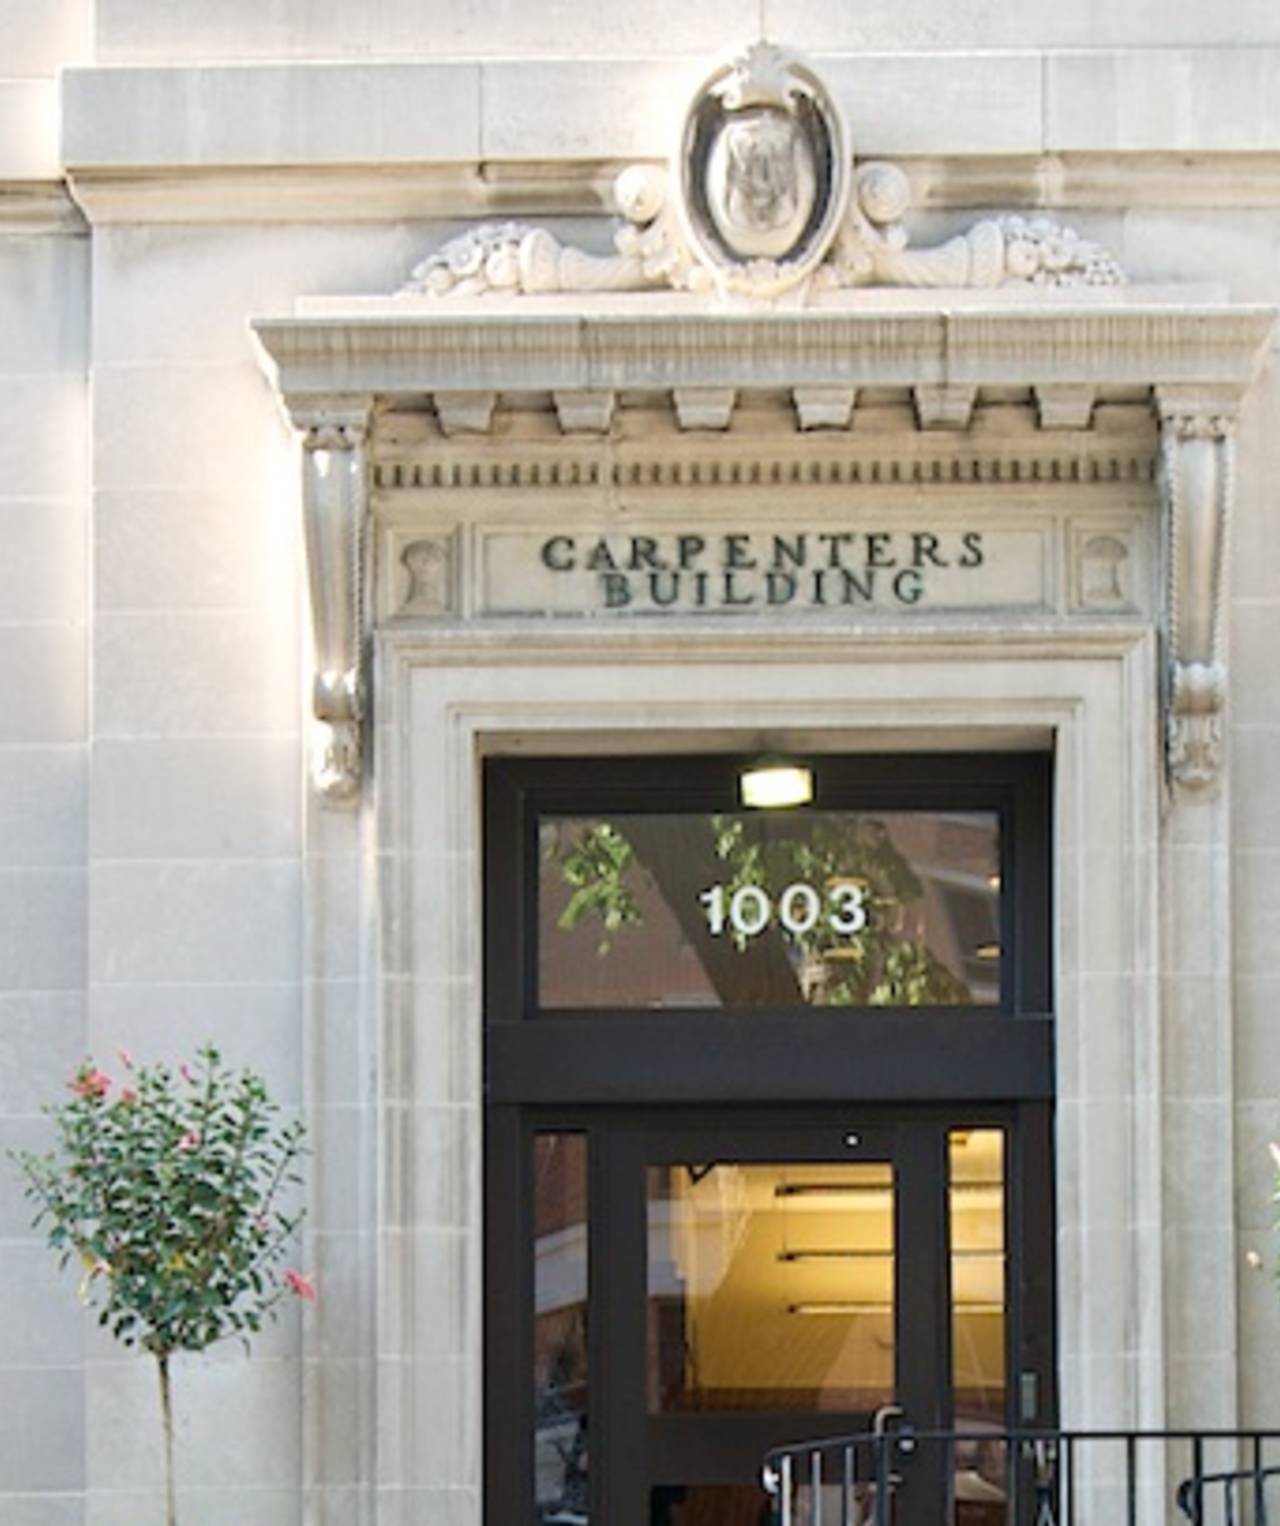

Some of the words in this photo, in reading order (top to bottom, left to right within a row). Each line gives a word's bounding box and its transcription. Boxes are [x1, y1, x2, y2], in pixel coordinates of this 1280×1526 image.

[540, 532, 985, 571] CARPENTERS
[599, 569, 925, 608] BUILDING
[699, 883, 867, 935] 1003
